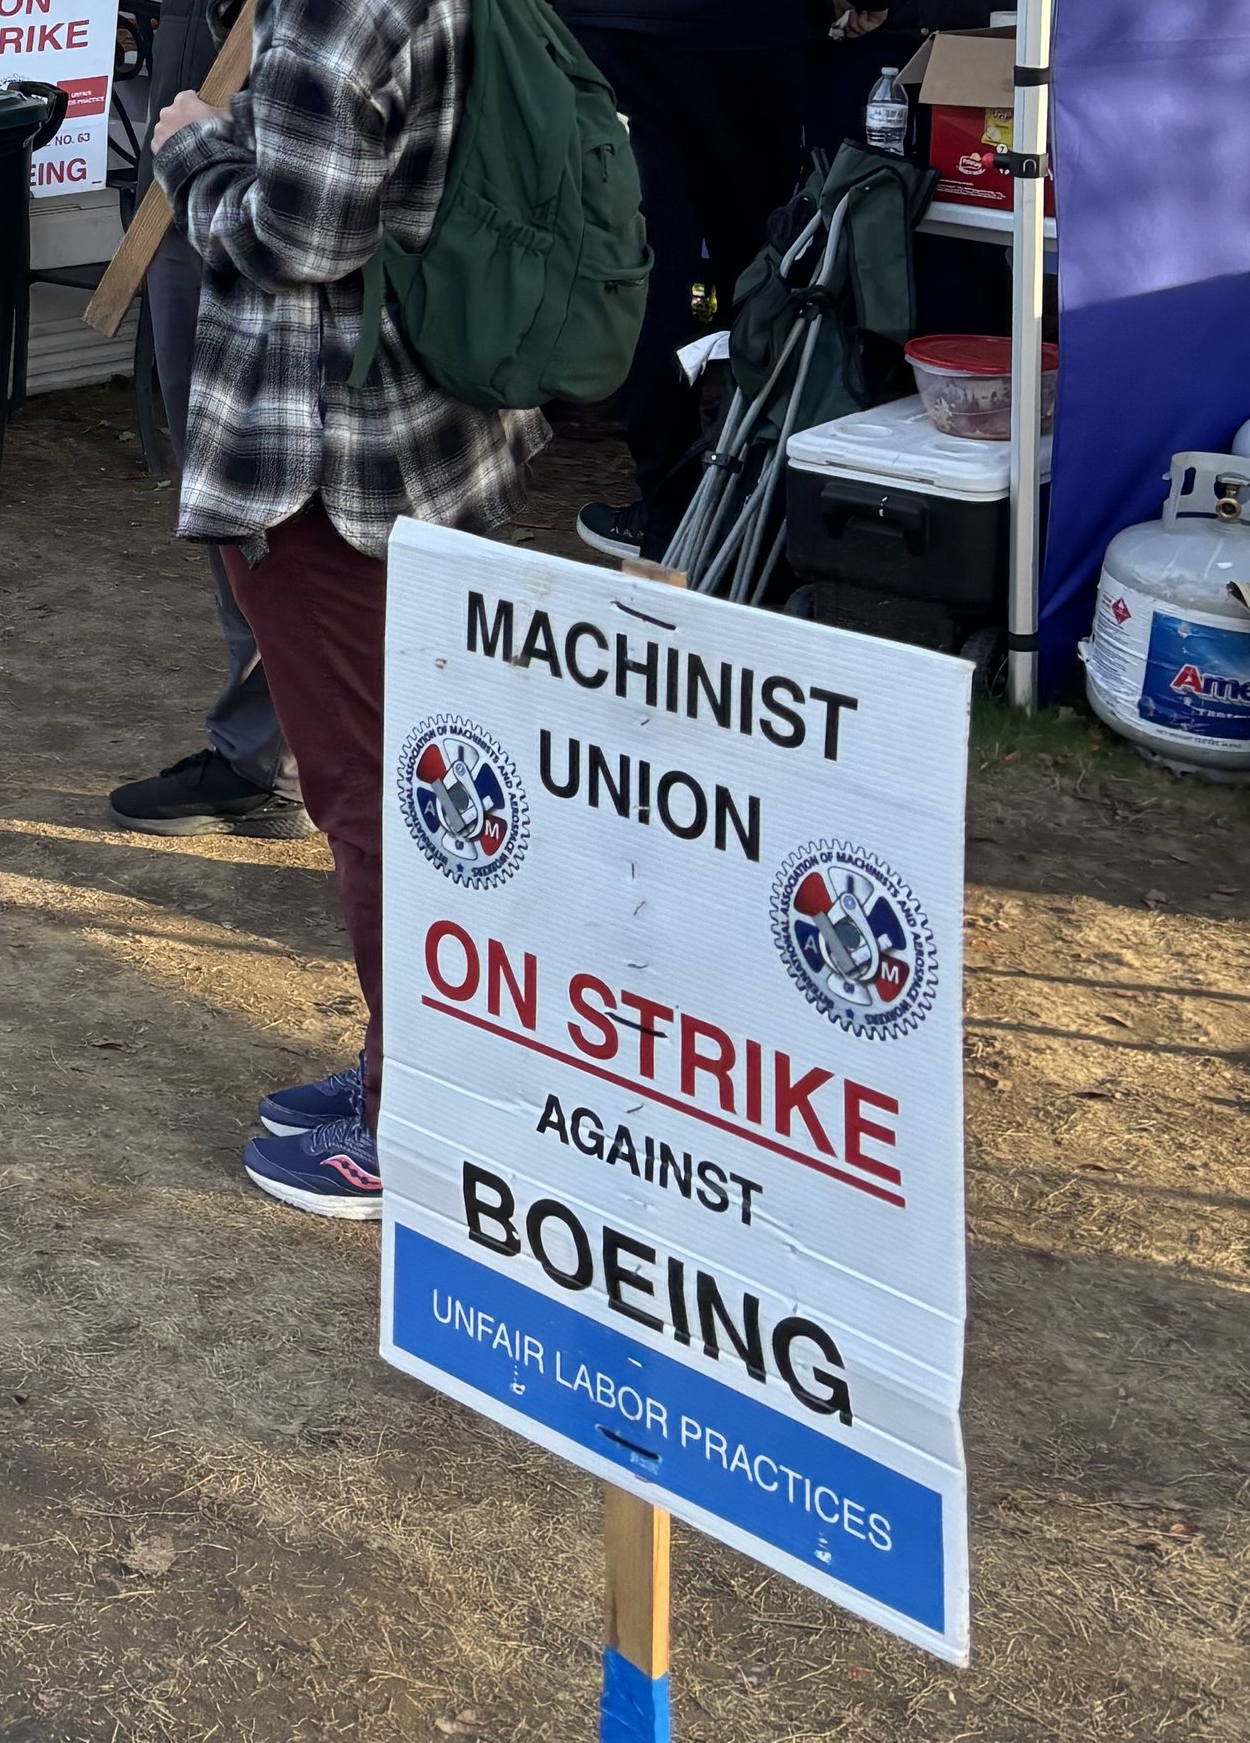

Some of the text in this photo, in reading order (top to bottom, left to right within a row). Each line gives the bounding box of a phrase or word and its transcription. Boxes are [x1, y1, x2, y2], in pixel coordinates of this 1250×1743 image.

[55, 133, 90, 146] NO. 63
[466, 590, 858, 762] MACHINIST
[405, 731, 436, 785] ASSOCIATION
[449, 726, 500, 764] MACHINISTS
[497, 765, 513, 789] AND
[540, 730, 761, 863] UNION
[484, 819, 500, 840] M
[504, 792, 520, 854] AEROSPACE
[780, 855, 820, 917] ASSOCIATION
[836, 851, 900, 898] MACHINISTS
[896, 899, 917, 928] AND
[880, 961, 899, 985] M
[906, 931, 925, 1001] AEROSPACE
[425, 919, 902, 1186] ON STRIKE
[536, 1093, 764, 1226] AGAINST
[462, 1160, 853, 1427] BOEING
[432, 1289, 893, 1552] UNFAIR LABOR PRACTICES
